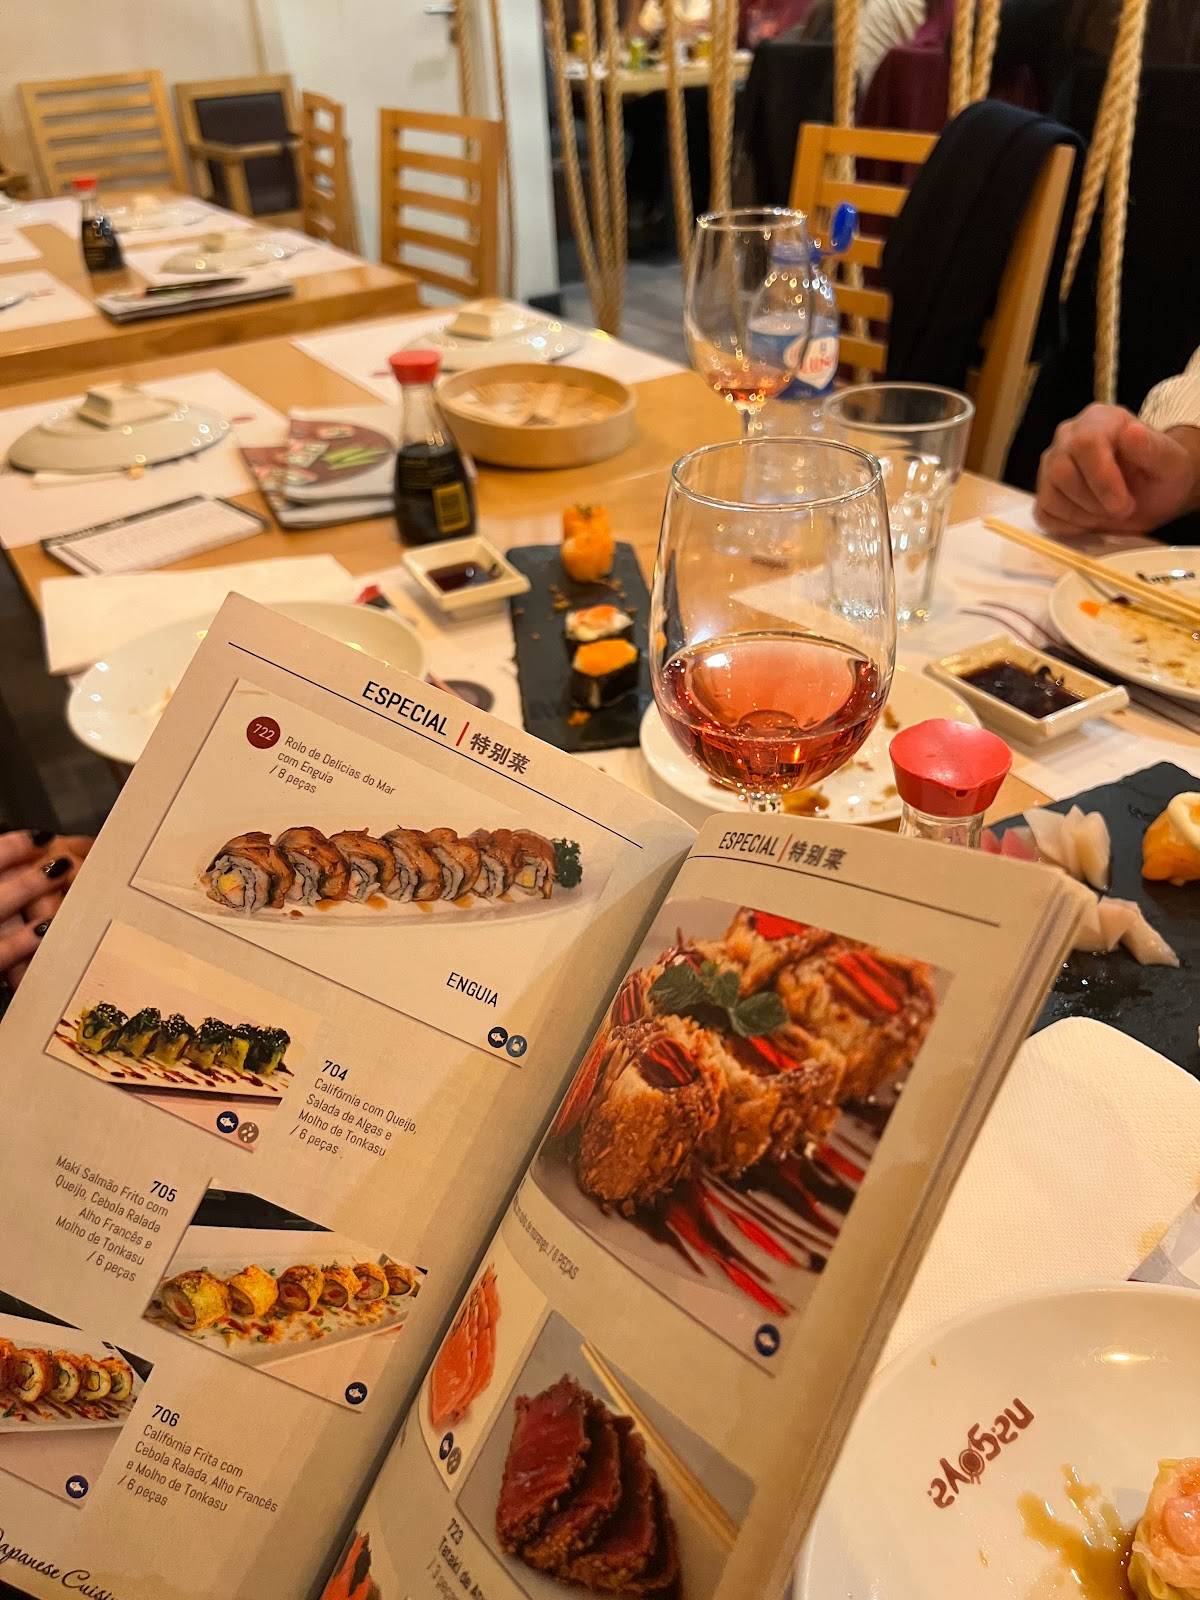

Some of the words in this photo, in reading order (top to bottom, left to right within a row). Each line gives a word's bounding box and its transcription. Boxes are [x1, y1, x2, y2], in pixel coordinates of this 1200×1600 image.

[362, 680, 448, 736] ESPECIAL
[253, 723, 275, 741] 722
[470, 732, 531, 774] 特别菜
[277, 752, 299, 768] com
[301, 761, 334, 784] Enguia
[278, 768, 287, 779] 8
[285, 774, 317, 794] peças
[284, 736, 307, 754] Rolo
[308, 747, 321, 760] de
[322, 753, 361, 780] Delícias
[362, 773, 375, 786] do
[376, 779, 396, 795] Mar
[718, 831, 780, 857] ESPECIAL
[787, 839, 848, 871] 特别菜
[446, 971, 499, 1008] ENGUIA
[322, 1060, 349, 1081] 704
[306, 1093, 340, 1117] Salada
[341, 1111, 355, 1124] de
[356, 1117, 384, 1137] Algas
[385, 1132, 392, 1141] e
[314, 1078, 361, 1107] Califórnia
[362, 1102, 384, 1118] com
[386, 1110, 417, 1135] Queijo,
[298, 1108, 329, 1131] Molho
[330, 1124, 343, 1137] de
[345, 1129, 386, 1157] Tonkasu
[299, 1128, 308, 1140] 6
[307, 1134, 339, 1154] peças
[55, 1155, 81, 1175] Maki
[81, 1167, 119, 1194] Salmão
[120, 1186, 145, 1206] Frito
[146, 1201, 169, 1217] com
[55, 1174, 87, 1200] Queijo,
[90, 1191, 124, 1216] Cebola
[125, 1208, 161, 1233] Ralada
[150, 1180, 178, 1202] 705
[55, 1215, 86, 1238] Molho
[87, 1231, 101, 1245] de
[102, 1237, 145, 1266] Tonkasu
[78, 1207, 101, 1225] Alho
[103, 1217, 143, 1245] Francês
[144, 1240, 153, 1249] e
[96, 1254, 105, 1266] 6
[104, 1261, 137, 1282] peças
[152, 1404, 181, 1427] 706
[143, 1424, 192, 1455] Califórnia
[193, 1447, 219, 1467] Frita
[220, 1462, 244, 1478] com
[927, 1398, 1035, 1509] nagoya
[127, 1460, 135, 1470] e
[136, 1463, 167, 1485] Molho
[168, 1478, 182, 1492] de
[184, 1485, 228, 1512] Tonkasu
[127, 1478, 135, 1490] 6
[134, 1485, 169, 1506] peças
[135, 1440, 170, 1466] Cebola
[171, 1459, 208, 1485] Ralada,
[211, 1476, 234, 1494] Alho
[235, 1486, 279, 1513] Francês
[0, 1527, 60, 1579] apanese
